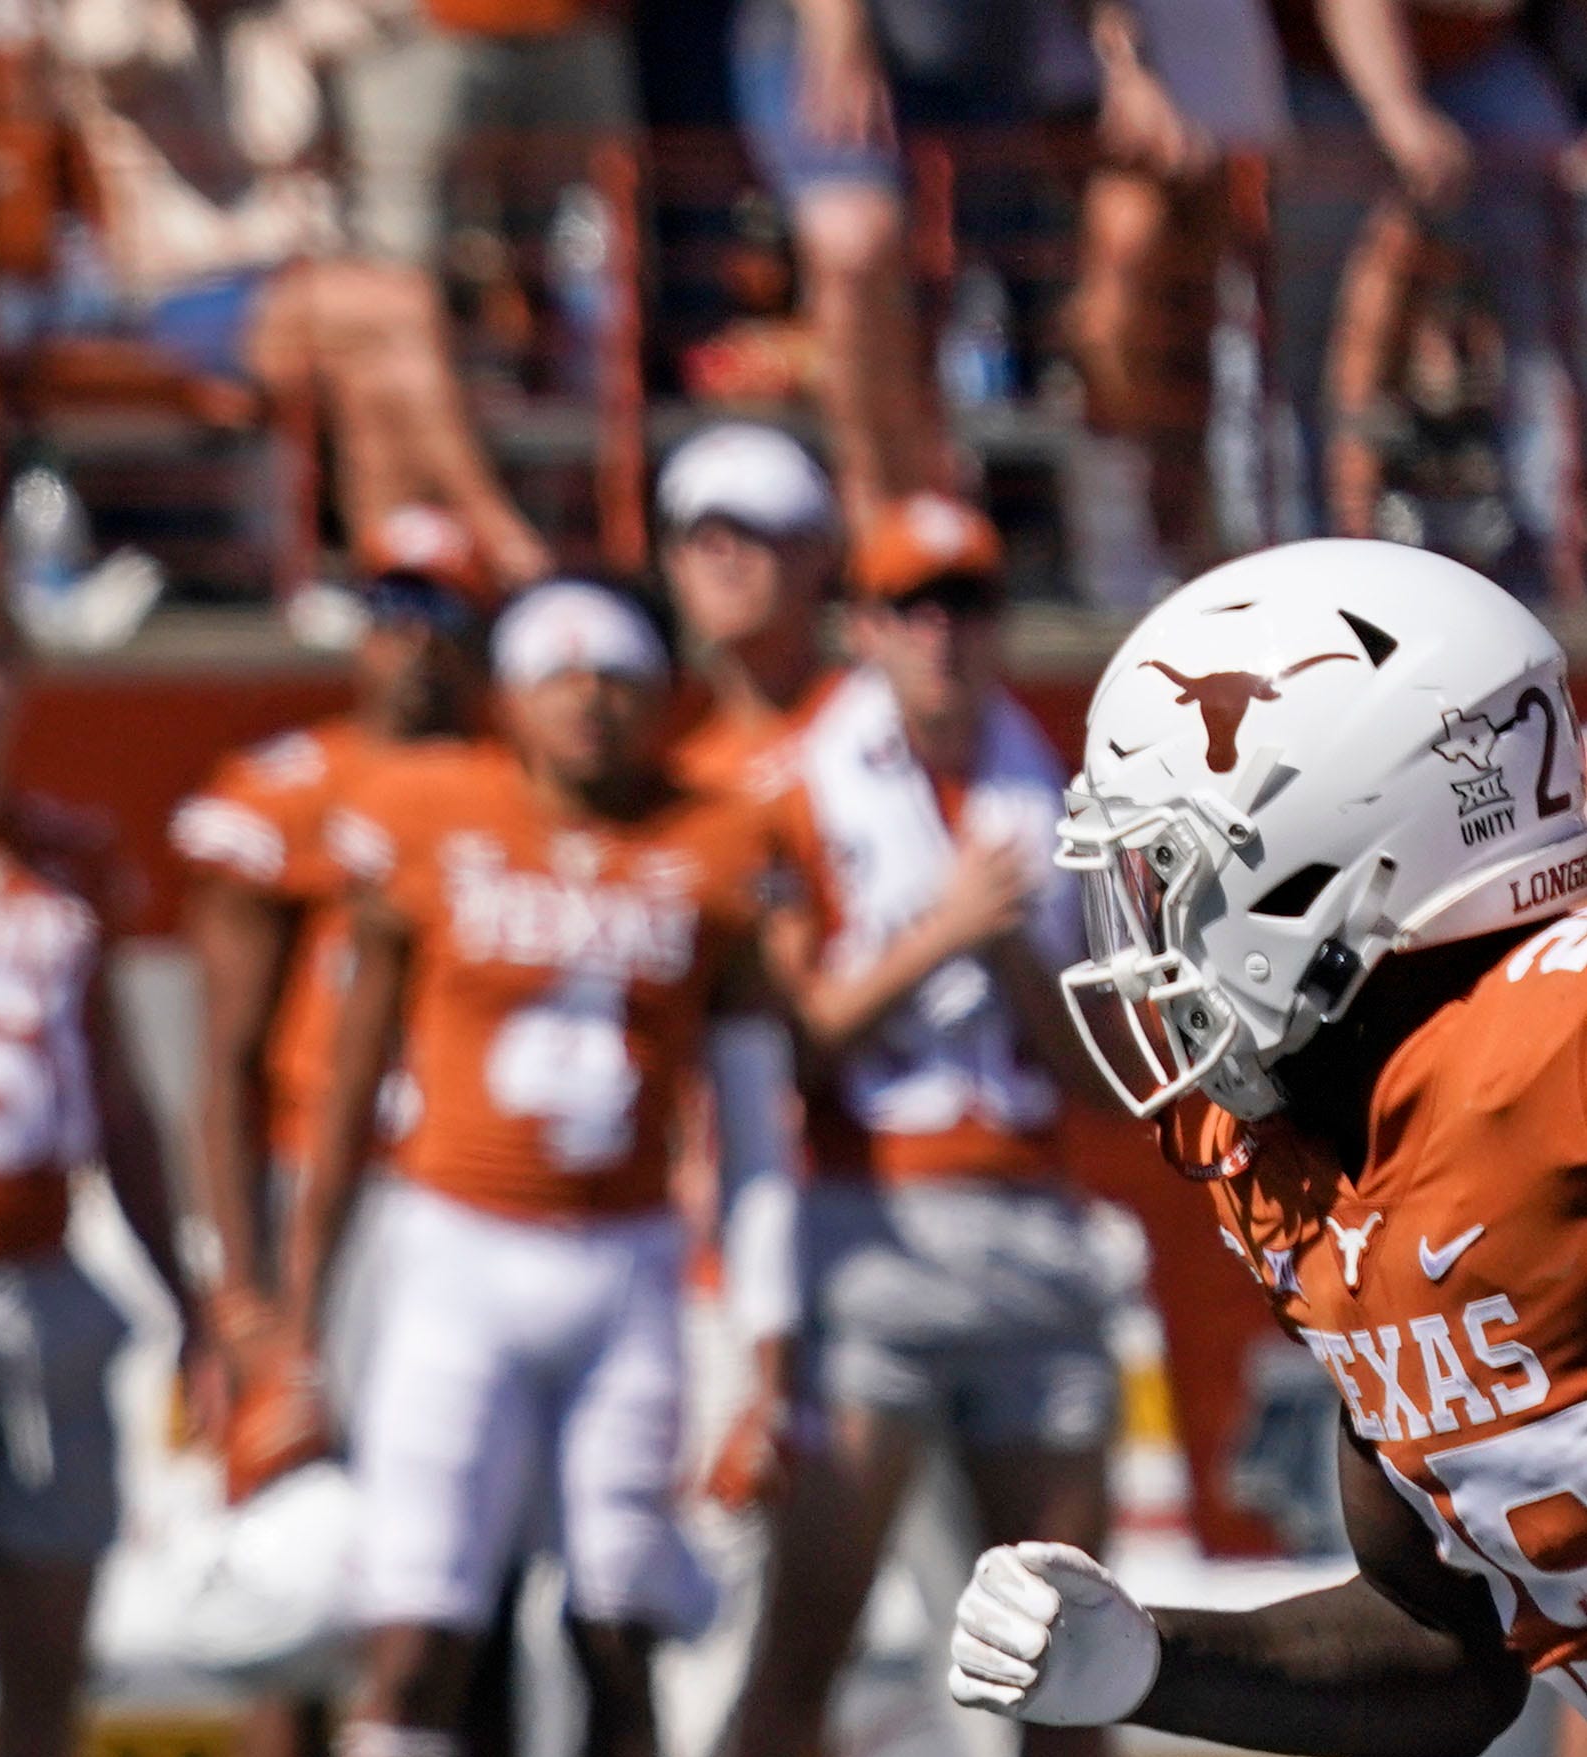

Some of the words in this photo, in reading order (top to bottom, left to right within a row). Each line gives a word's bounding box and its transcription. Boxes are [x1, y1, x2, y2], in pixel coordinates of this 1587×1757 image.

[1459, 806, 1516, 846] UNITY
[1509, 856, 1587, 915] LONG
[484, 980, 641, 1172] 4
